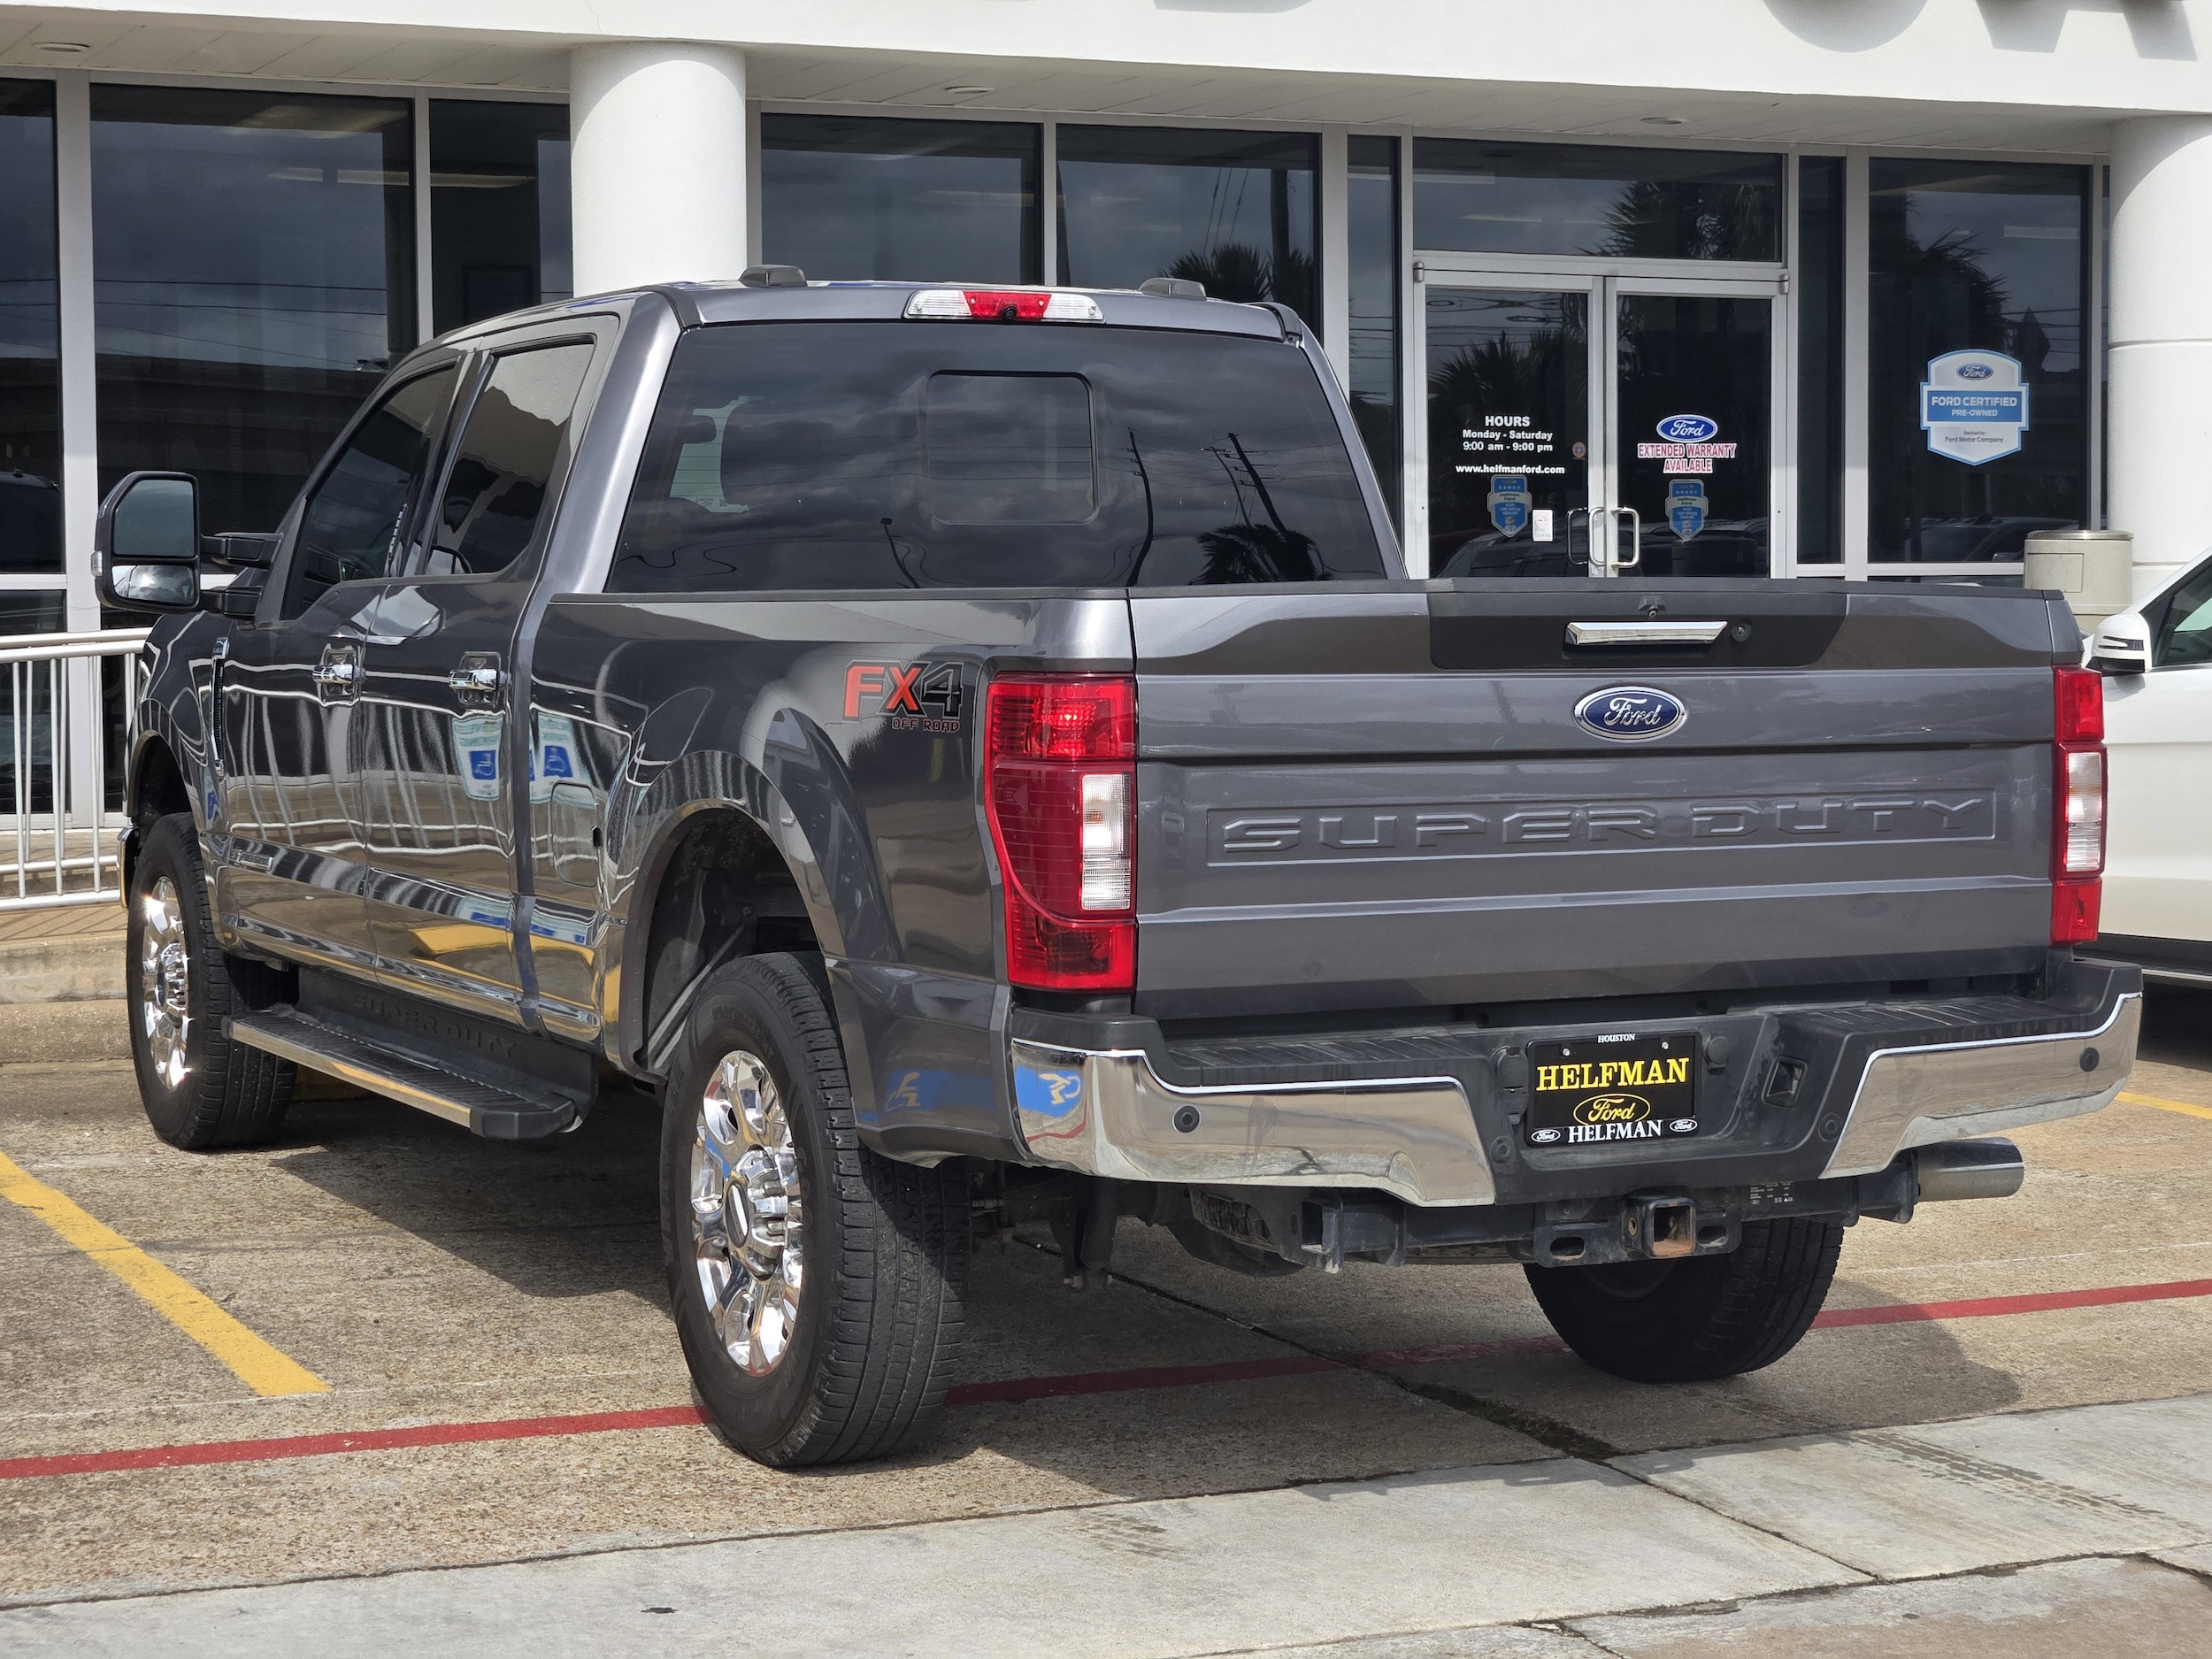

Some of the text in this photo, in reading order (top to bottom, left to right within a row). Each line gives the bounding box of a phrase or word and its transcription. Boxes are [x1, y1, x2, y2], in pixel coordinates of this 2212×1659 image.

[1932, 396, 2017, 407] FORD CERTIFIED
[1485, 416, 1531, 427] HOURS
[1463, 429, 1501, 441] Monday
[1509, 430, 1553, 442] Saturday
[1463, 441, 1485, 450] 9:00
[1512, 442, 1535, 451] 9:00
[1537, 444, 1554, 453] pm
[1638, 444, 1736, 457] EXTENDED WARRANTY
[1455, 465, 1565, 474] www.helfmanford.com
[1663, 459, 1712, 472] AVAILABLE
[842, 659, 964, 724] FX4
[892, 717, 960, 733] OFF ROAD
[1223, 798, 1984, 853] SUPER DUTY
[1597, 1033, 1636, 1043] HOUSTON
[1536, 1057, 1690, 1091] HELFMAN
[1587, 1097, 1636, 1122] Ford
[1568, 1119, 1663, 1143] HELFMAN
